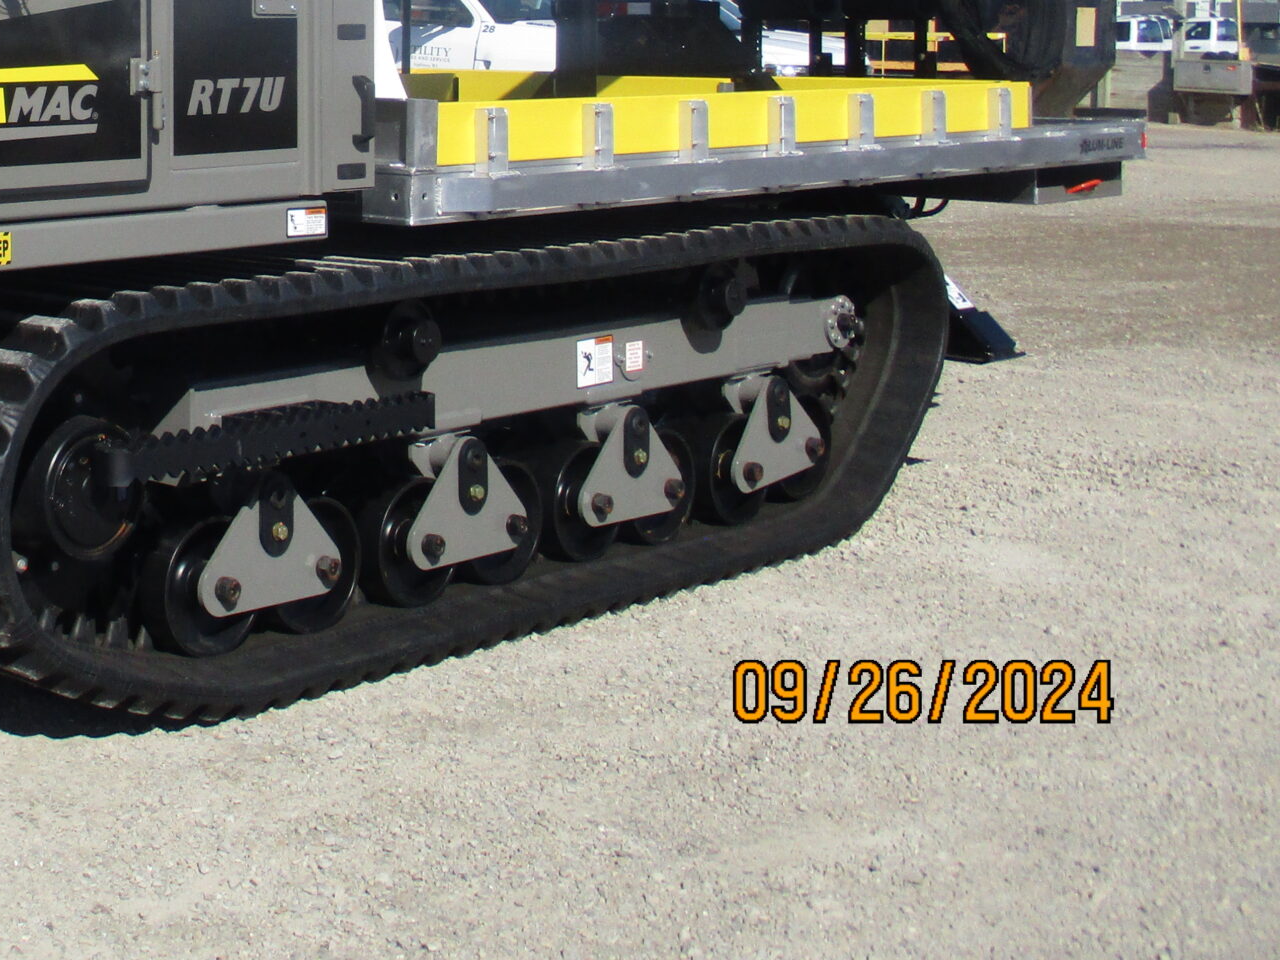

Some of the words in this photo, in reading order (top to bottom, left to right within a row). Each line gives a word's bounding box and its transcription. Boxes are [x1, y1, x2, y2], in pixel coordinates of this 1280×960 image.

[482, 24, 496, 33] 28
[412, 43, 452, 57] TILITY
[186, 76, 286, 116] RT7U
